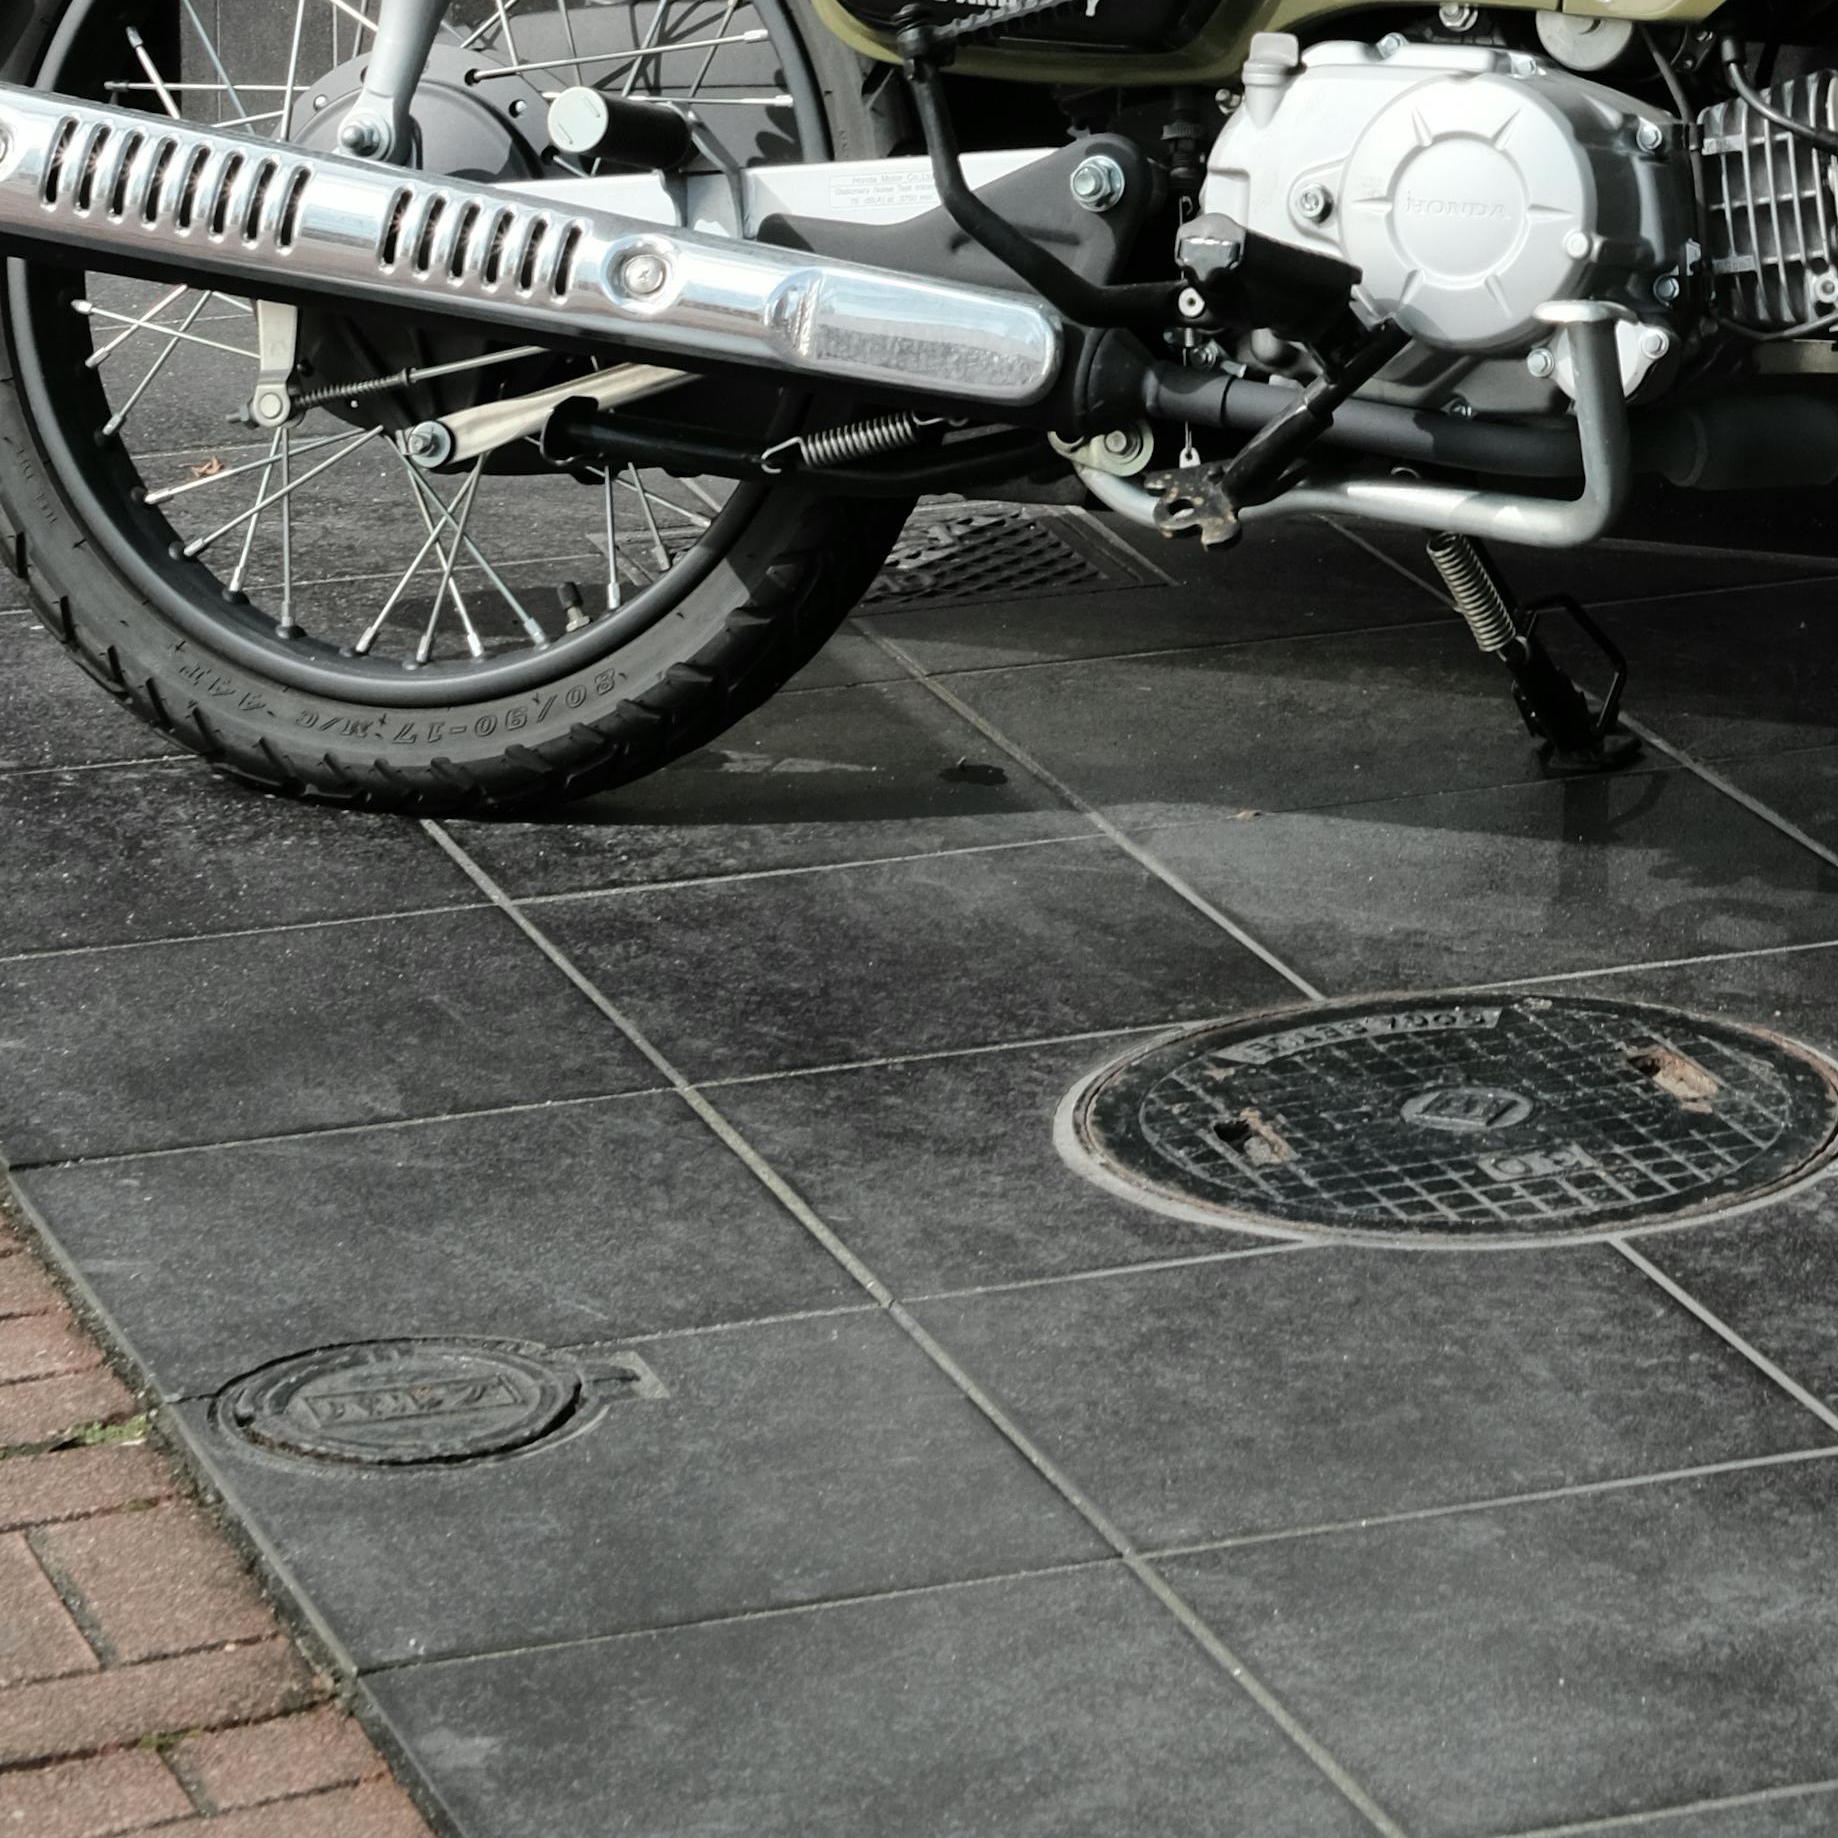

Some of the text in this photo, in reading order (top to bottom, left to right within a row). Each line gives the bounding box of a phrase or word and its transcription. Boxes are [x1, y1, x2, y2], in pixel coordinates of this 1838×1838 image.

[1405, 190, 1512, 220] HONDA
[391, 667, 616, 745] 80/90-17
[297, 710, 369, 738] M/C
